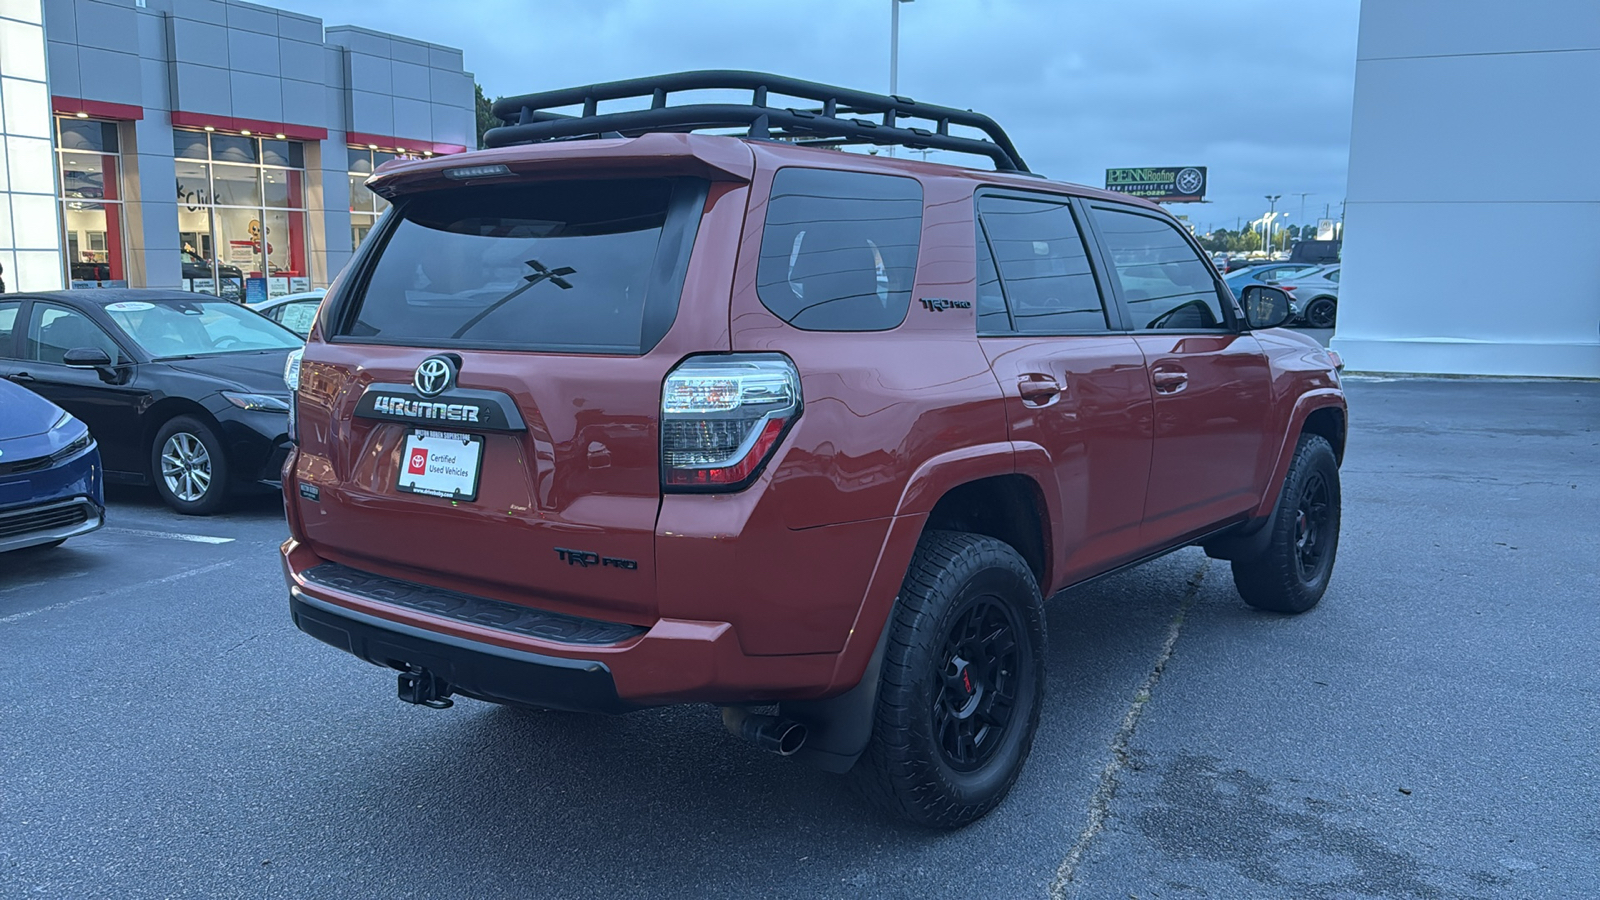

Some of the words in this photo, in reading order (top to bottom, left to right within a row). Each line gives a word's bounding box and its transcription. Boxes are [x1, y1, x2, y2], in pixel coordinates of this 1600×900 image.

[1107, 168, 1149, 181] PENN
[1148, 169, 1175, 183] Roofing
[919, 298, 950, 312] TRD
[950, 300, 971, 309] PRO
[374, 396, 480, 422] 4RUNNER
[430, 453, 457, 464] Certified
[429, 465, 444, 474] Used
[445, 466, 469, 478] Vehicles
[553, 546, 600, 568] TRD
[601, 556, 638, 570] PRO
